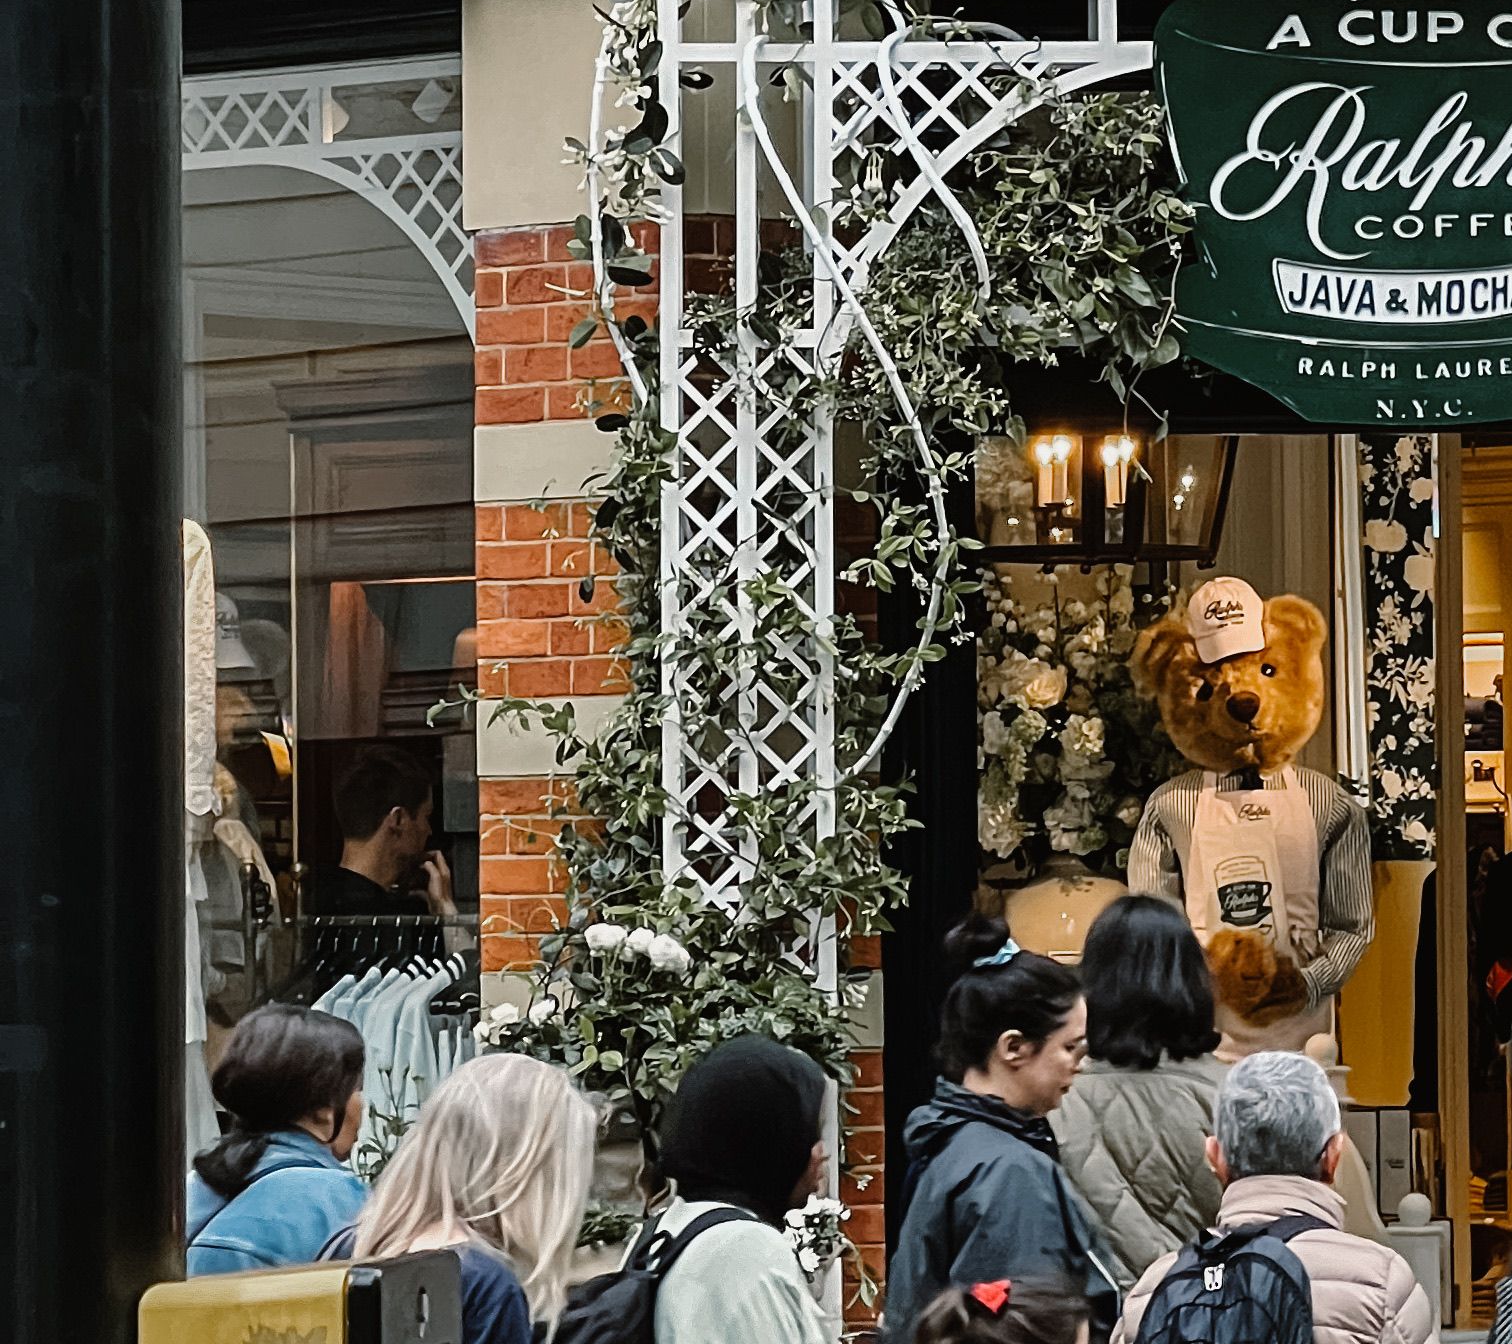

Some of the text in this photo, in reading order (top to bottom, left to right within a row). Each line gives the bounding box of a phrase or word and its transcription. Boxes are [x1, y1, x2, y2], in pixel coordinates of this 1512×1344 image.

[1265, 14, 1311, 50] A
[1338, 9, 1464, 46] CUP
[1288, 272, 1376, 316] JAVA
[1384, 288, 1409, 314] &
[1298, 357, 1396, 379] RALPH
[1376, 399, 1473, 419] N.Y.C.
